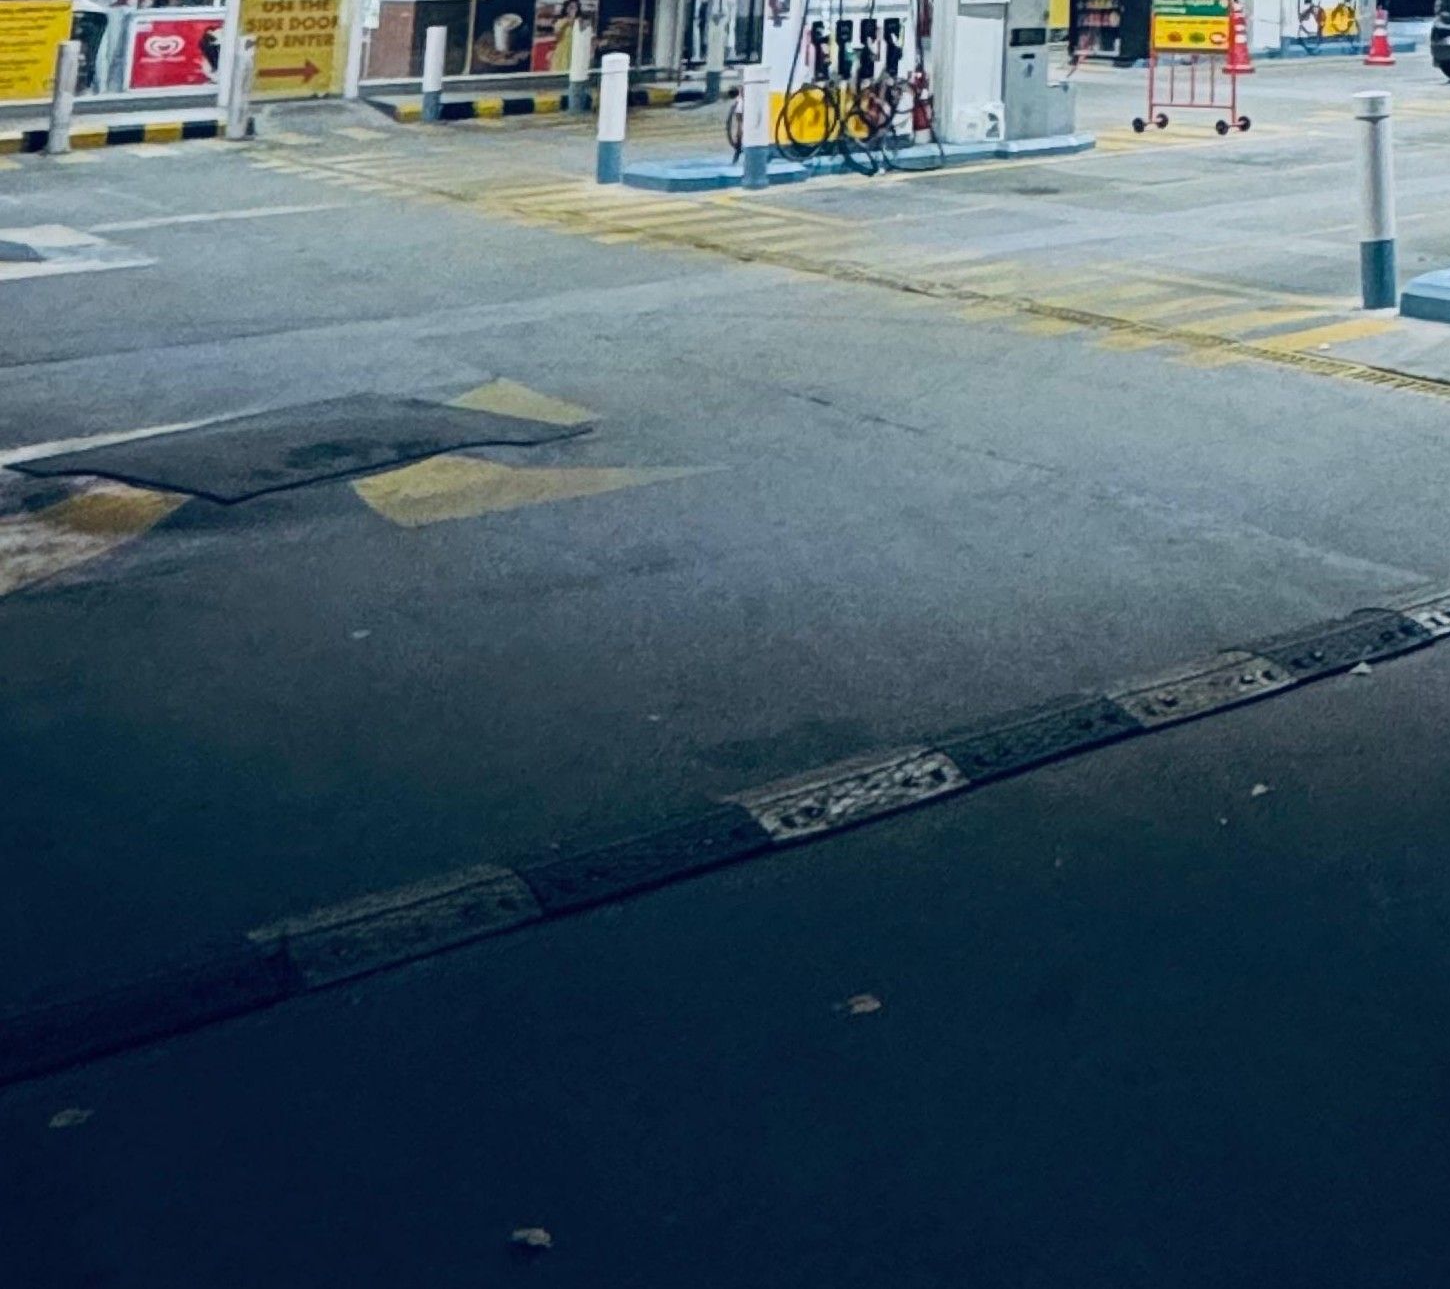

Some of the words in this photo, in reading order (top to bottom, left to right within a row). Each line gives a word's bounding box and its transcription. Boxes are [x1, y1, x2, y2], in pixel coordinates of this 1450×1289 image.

[262, 0, 292, 14] USE
[299, 0, 331, 13] THE
[283, 34, 334, 49] ENTER
